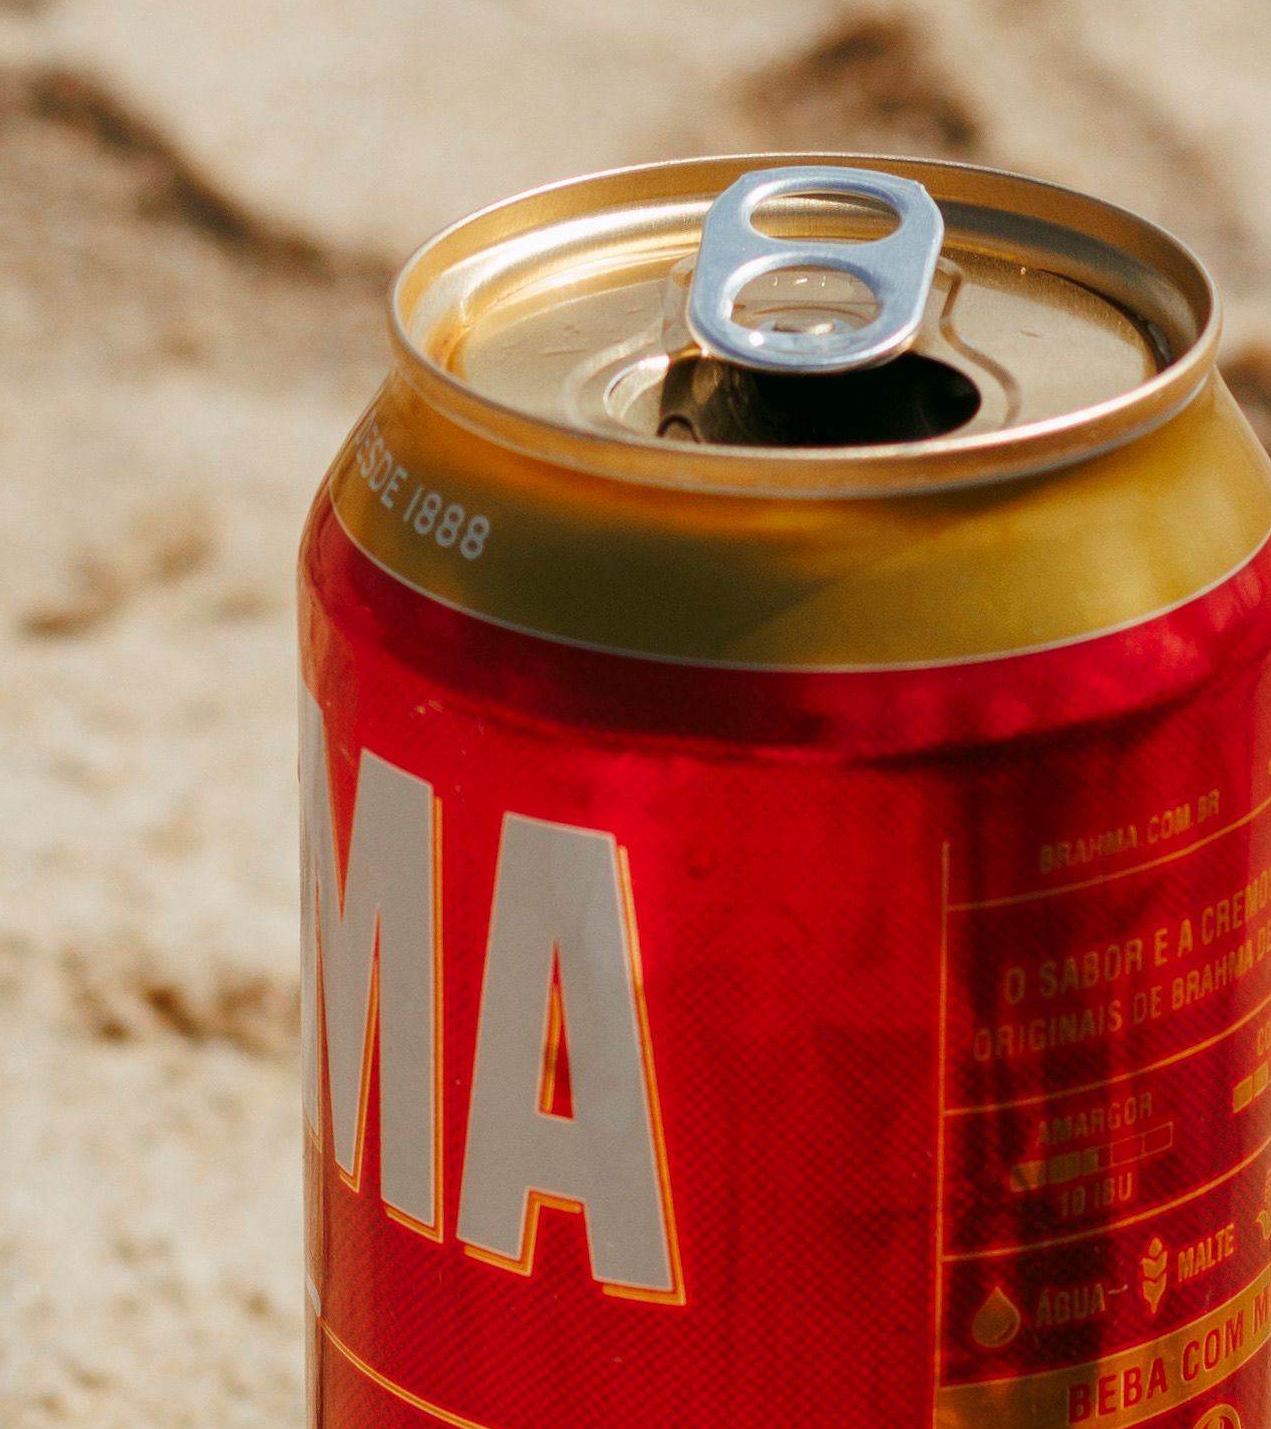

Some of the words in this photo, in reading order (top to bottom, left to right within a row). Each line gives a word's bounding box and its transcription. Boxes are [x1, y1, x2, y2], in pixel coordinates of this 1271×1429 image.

[402, 485, 491, 560] 1888
[973, 999, 1123, 1063] ORIGINAIS
[1133, 985, 1162, 1026] DE
[1171, 939, 1254, 1011] BRAHMA
[1003, 965, 1026, 1006] O
[1038, 937, 1143, 1000] SABOR
[1153, 927, 1169, 966] E
[1177, 918, 1194, 959] A
[1034, 1092, 1153, 1148] AMARGOR
[1034, 1283, 1107, 1329] ÁGUA
[1177, 1223, 1235, 1282] MALTE
[1066, 1356, 1169, 1426] BEBA
[1181, 1310, 1244, 1383] COM
